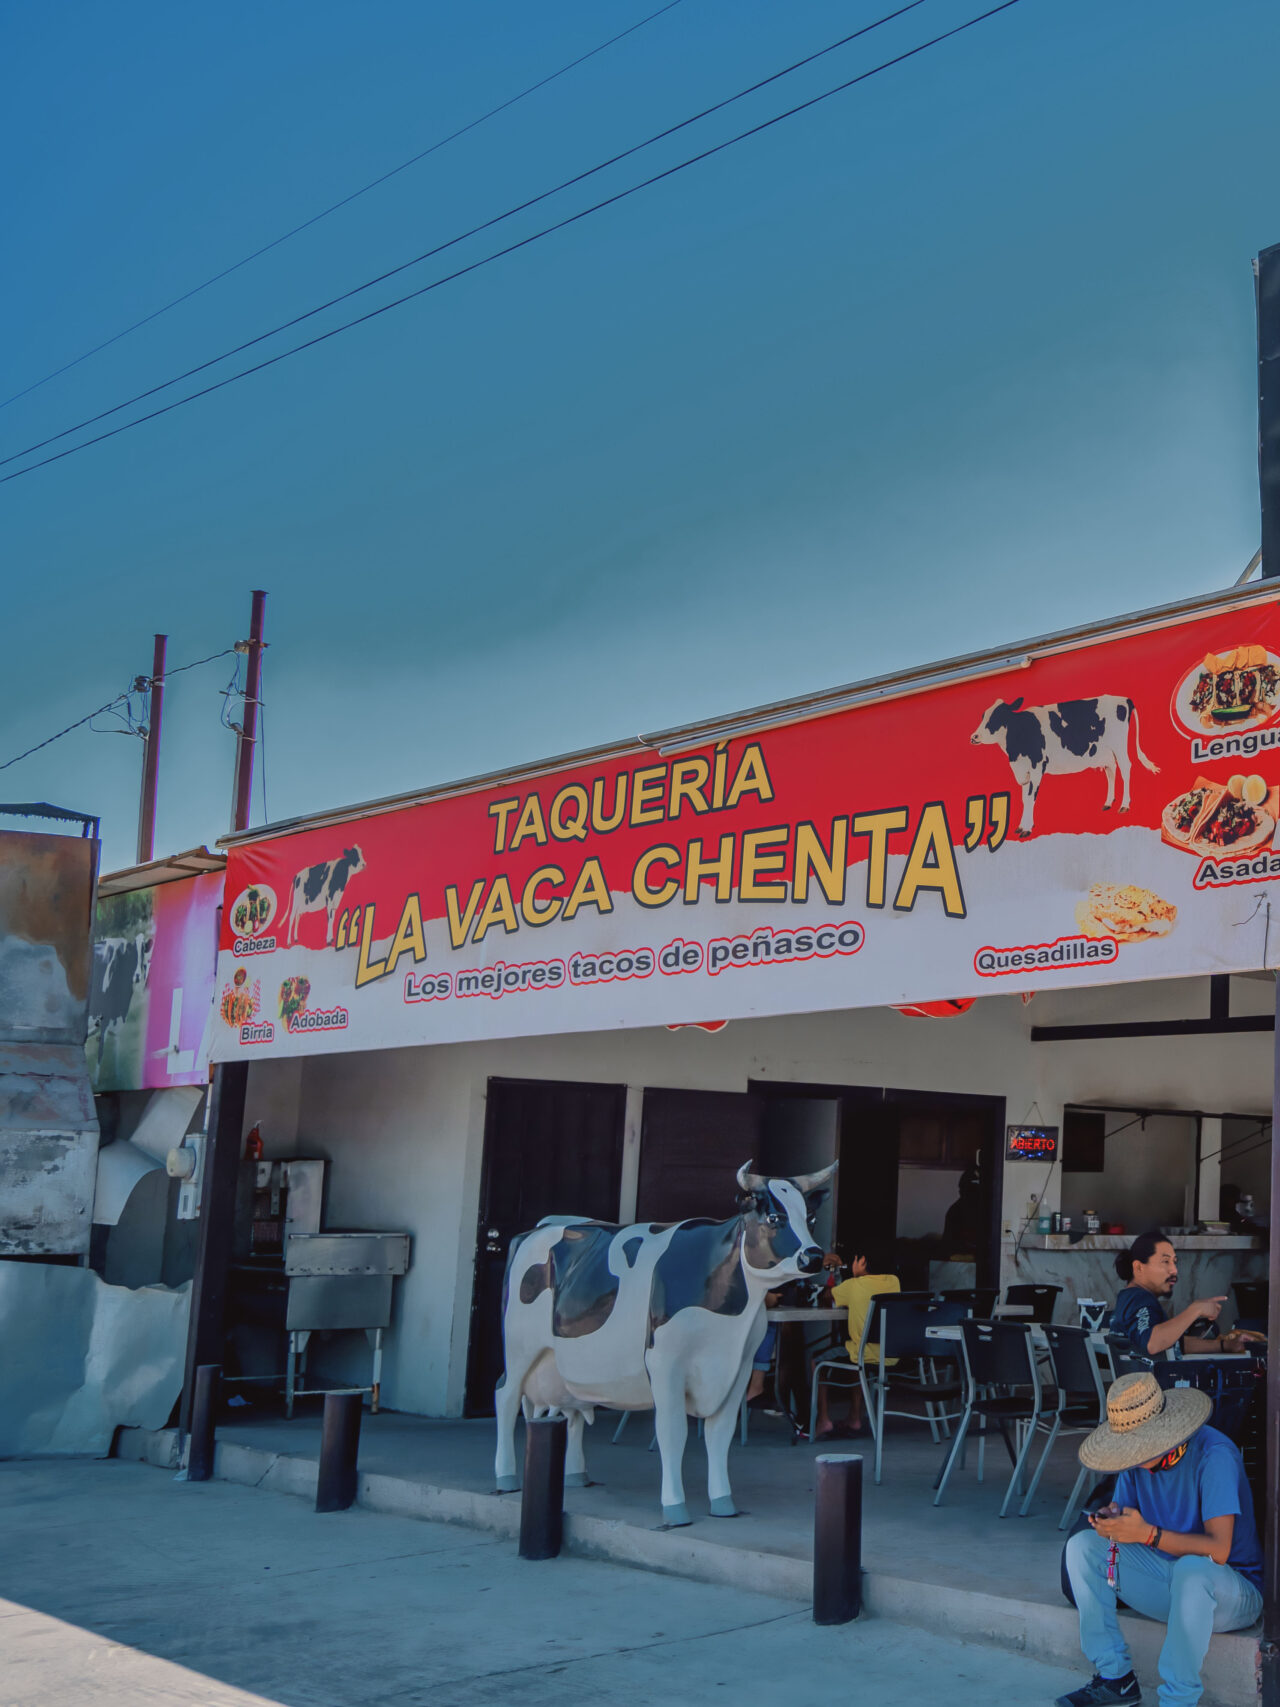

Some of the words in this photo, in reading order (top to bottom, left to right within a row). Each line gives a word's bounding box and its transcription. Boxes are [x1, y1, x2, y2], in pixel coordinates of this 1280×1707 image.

[487, 741, 774, 854] TAQUERÍA
[334, 893, 427, 990] “LA
[445, 857, 615, 950] VACA
[632, 790, 1012, 919] CHENTA”
[234, 934, 276, 955] Cabeza
[978, 939, 1114, 971] Quesadillas
[406, 971, 450, 998] Los
[458, 960, 562, 997] mejores
[571, 953, 651, 985] tacos
[662, 942, 700, 971] de
[710, 926, 861, 970] peñasco
[241, 1023, 274, 1042] Birria
[290, 1008, 347, 1030] Adobada
[1010, 1138, 1055, 1151] ABIERTO
